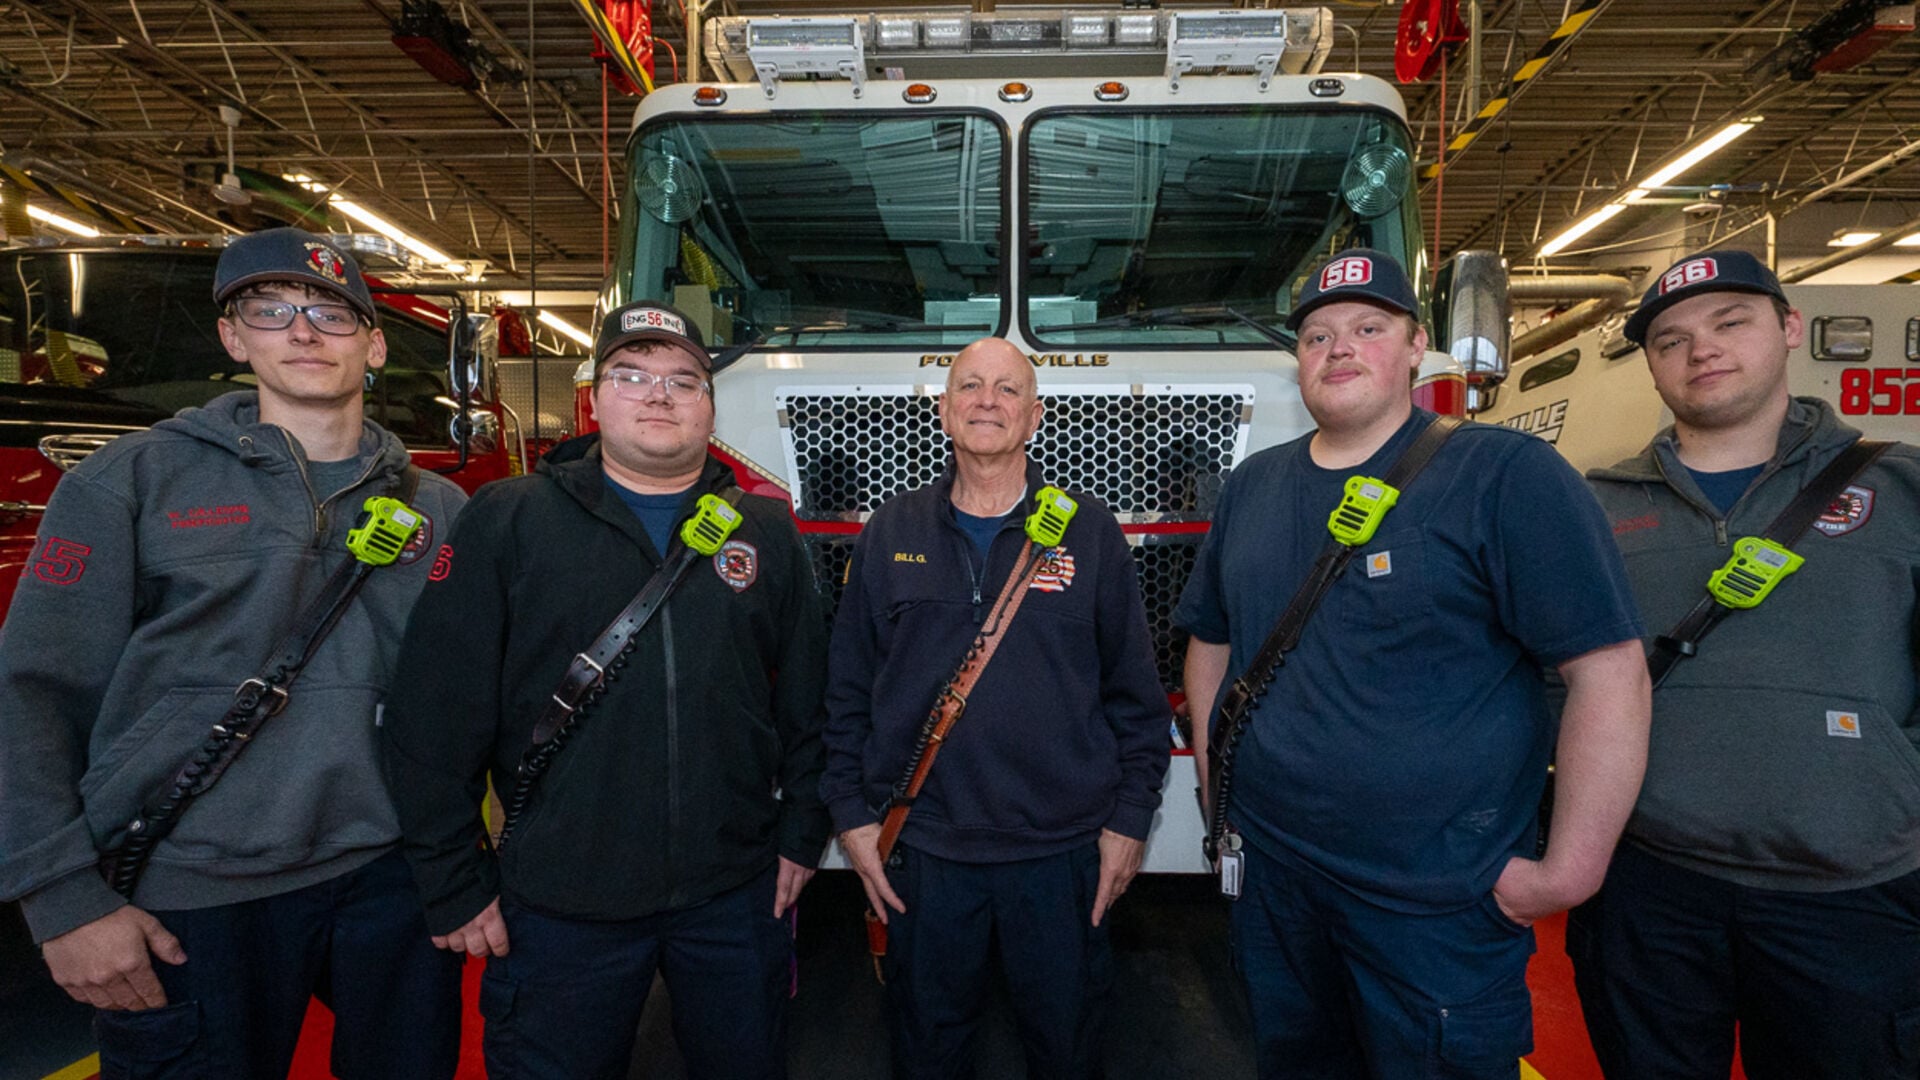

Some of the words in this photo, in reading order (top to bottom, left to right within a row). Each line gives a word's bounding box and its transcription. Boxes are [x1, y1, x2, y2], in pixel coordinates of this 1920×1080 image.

[1326, 260, 1364, 287] 56
[1665, 261, 1708, 292] 56
[626, 314, 647, 328] ENG
[647, 311, 663, 326] 56
[1840, 368, 1920, 415] 852
[21, 537, 92, 586] 5
[894, 552, 915, 562] BILL
[916, 554, 928, 563] G.
